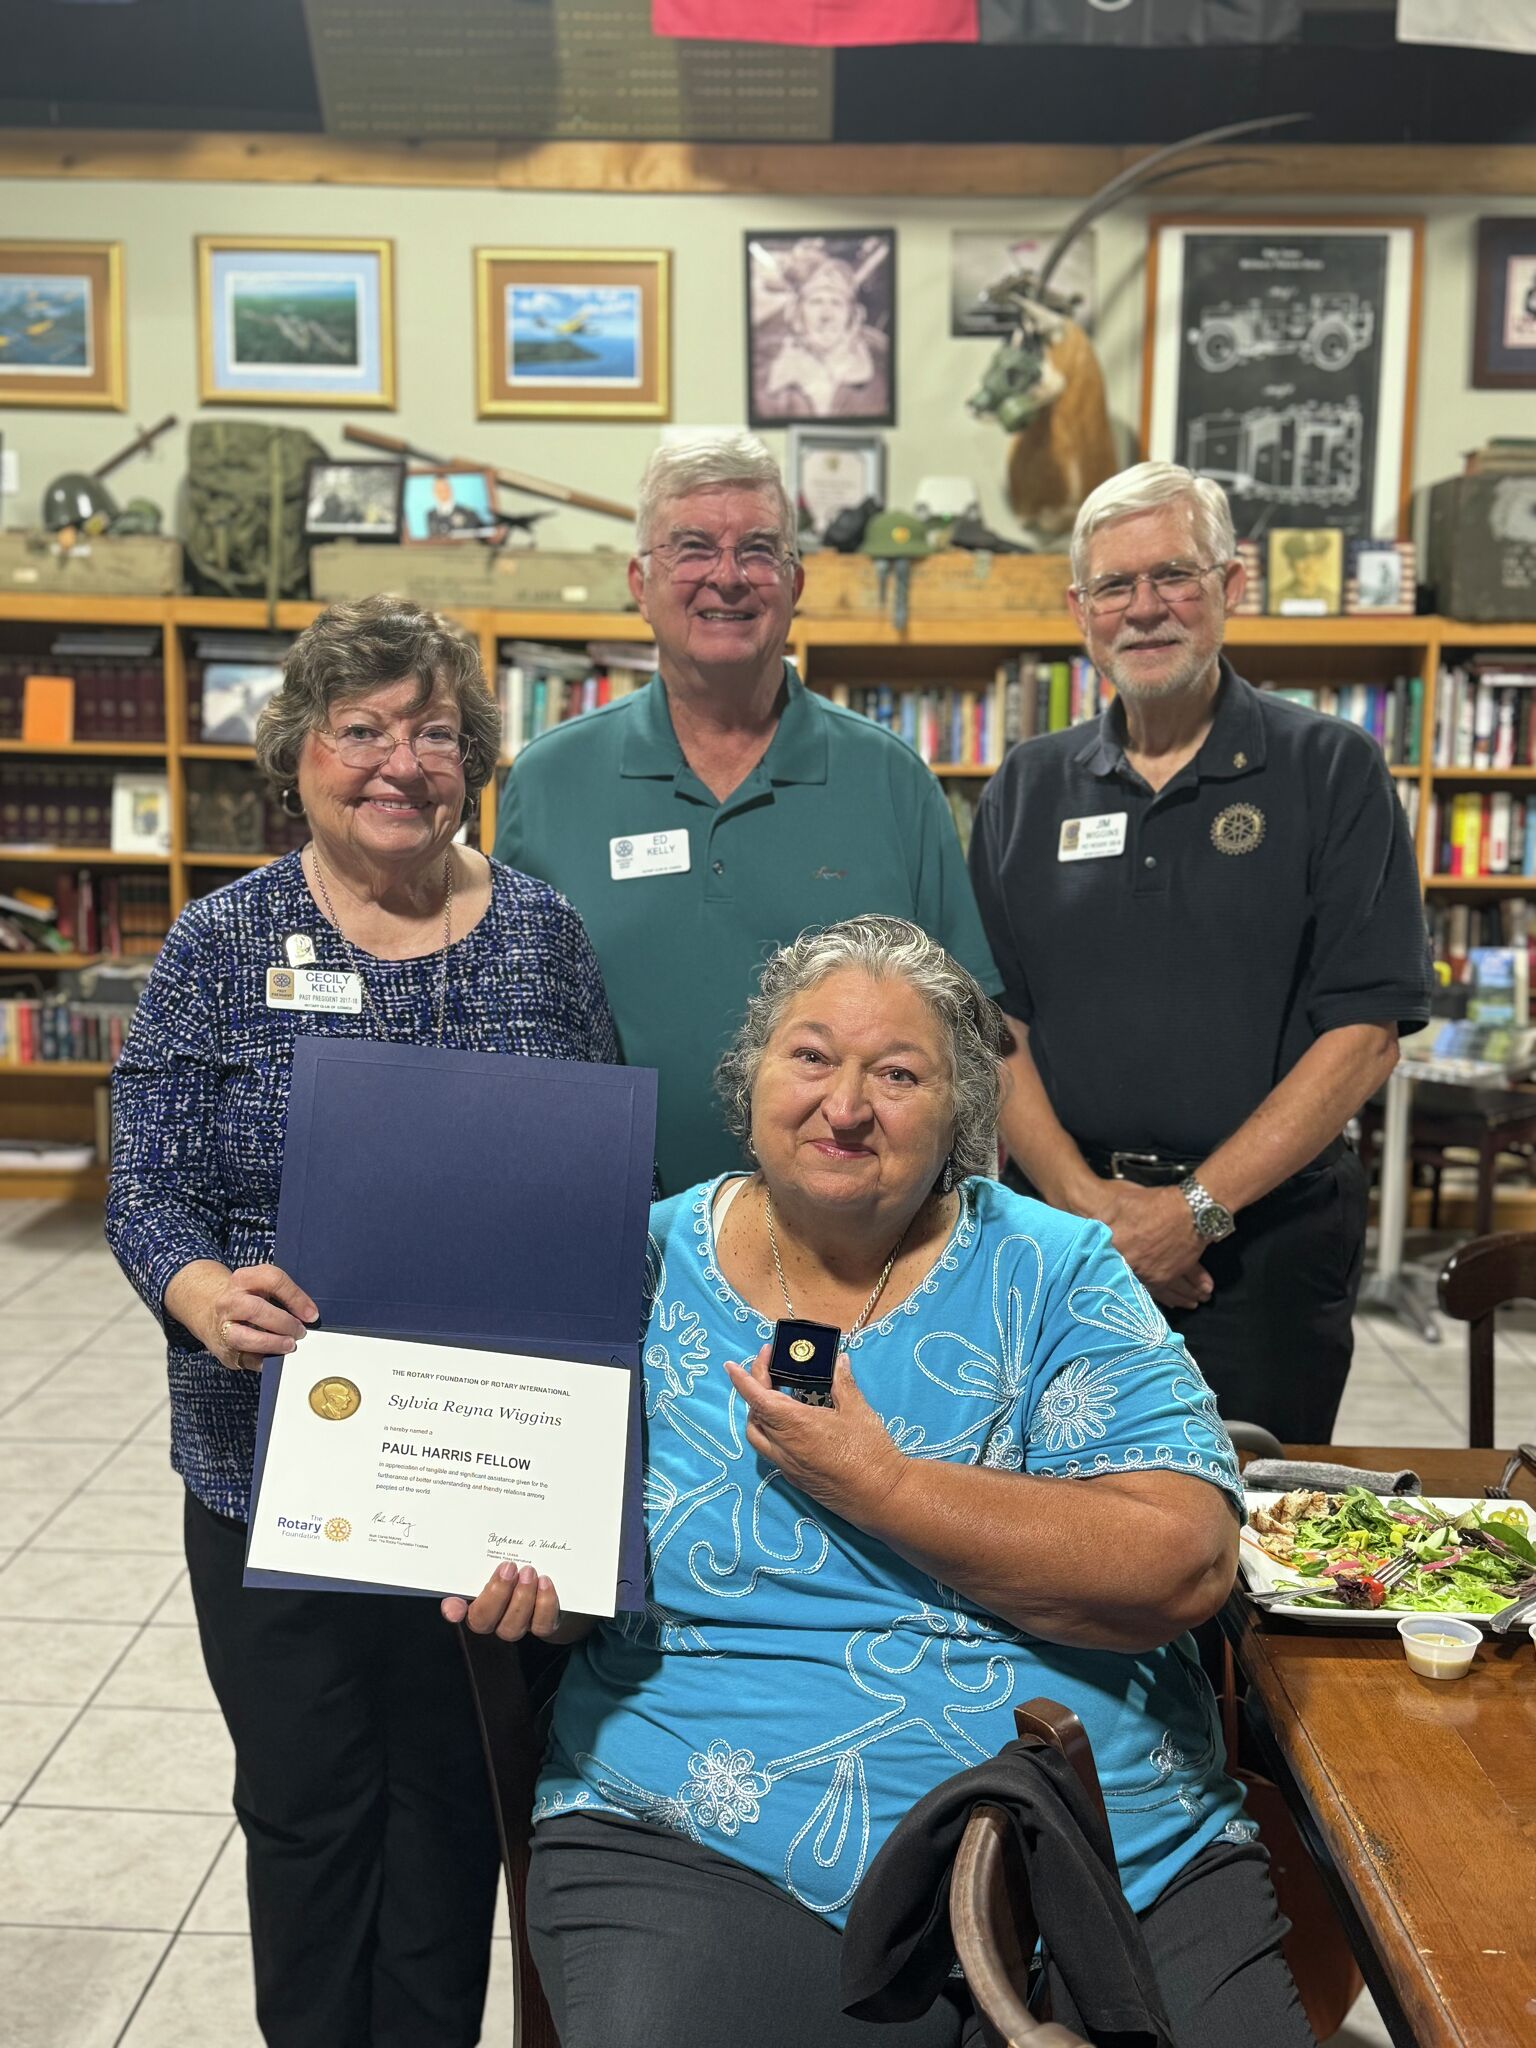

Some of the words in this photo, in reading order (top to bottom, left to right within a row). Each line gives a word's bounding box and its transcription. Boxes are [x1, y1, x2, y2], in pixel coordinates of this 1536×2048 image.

[1096, 818, 1111, 830] JIM
[653, 834, 668, 846] ED
[647, 844, 676, 856] KELLY
[306, 972, 352, 984] CECILY
[311, 984, 346, 994] KELLY
[406, 1371, 434, 1379] ROTARY
[436, 1374, 479, 1385] FOUNDATION
[491, 1381, 518, 1390] ROTARY
[519, 1384, 571, 1397] INTERNATIONAL
[388, 1394, 438, 1410] Sylvia
[442, 1400, 493, 1418] Reyna
[500, 1406, 562, 1426] Wiggins
[381, 1442, 418, 1457] PAUL
[422, 1446, 472, 1463] HARRIS
[476, 1452, 531, 1471] FELLOW
[385, 1462, 418, 1471] appreciation
[426, 1466, 447, 1474] tangible
[460, 1470, 486, 1479] significant
[487, 1475, 515, 1483] assistance
[377, 1472, 408, 1480] furtherance
[432, 1480, 471, 1489] understanding
[483, 1485, 502, 1494] friendly
[503, 1488, 526, 1497] relations
[277, 1517, 322, 1533] Rotary
[281, 1530, 320, 1540] Foundation
